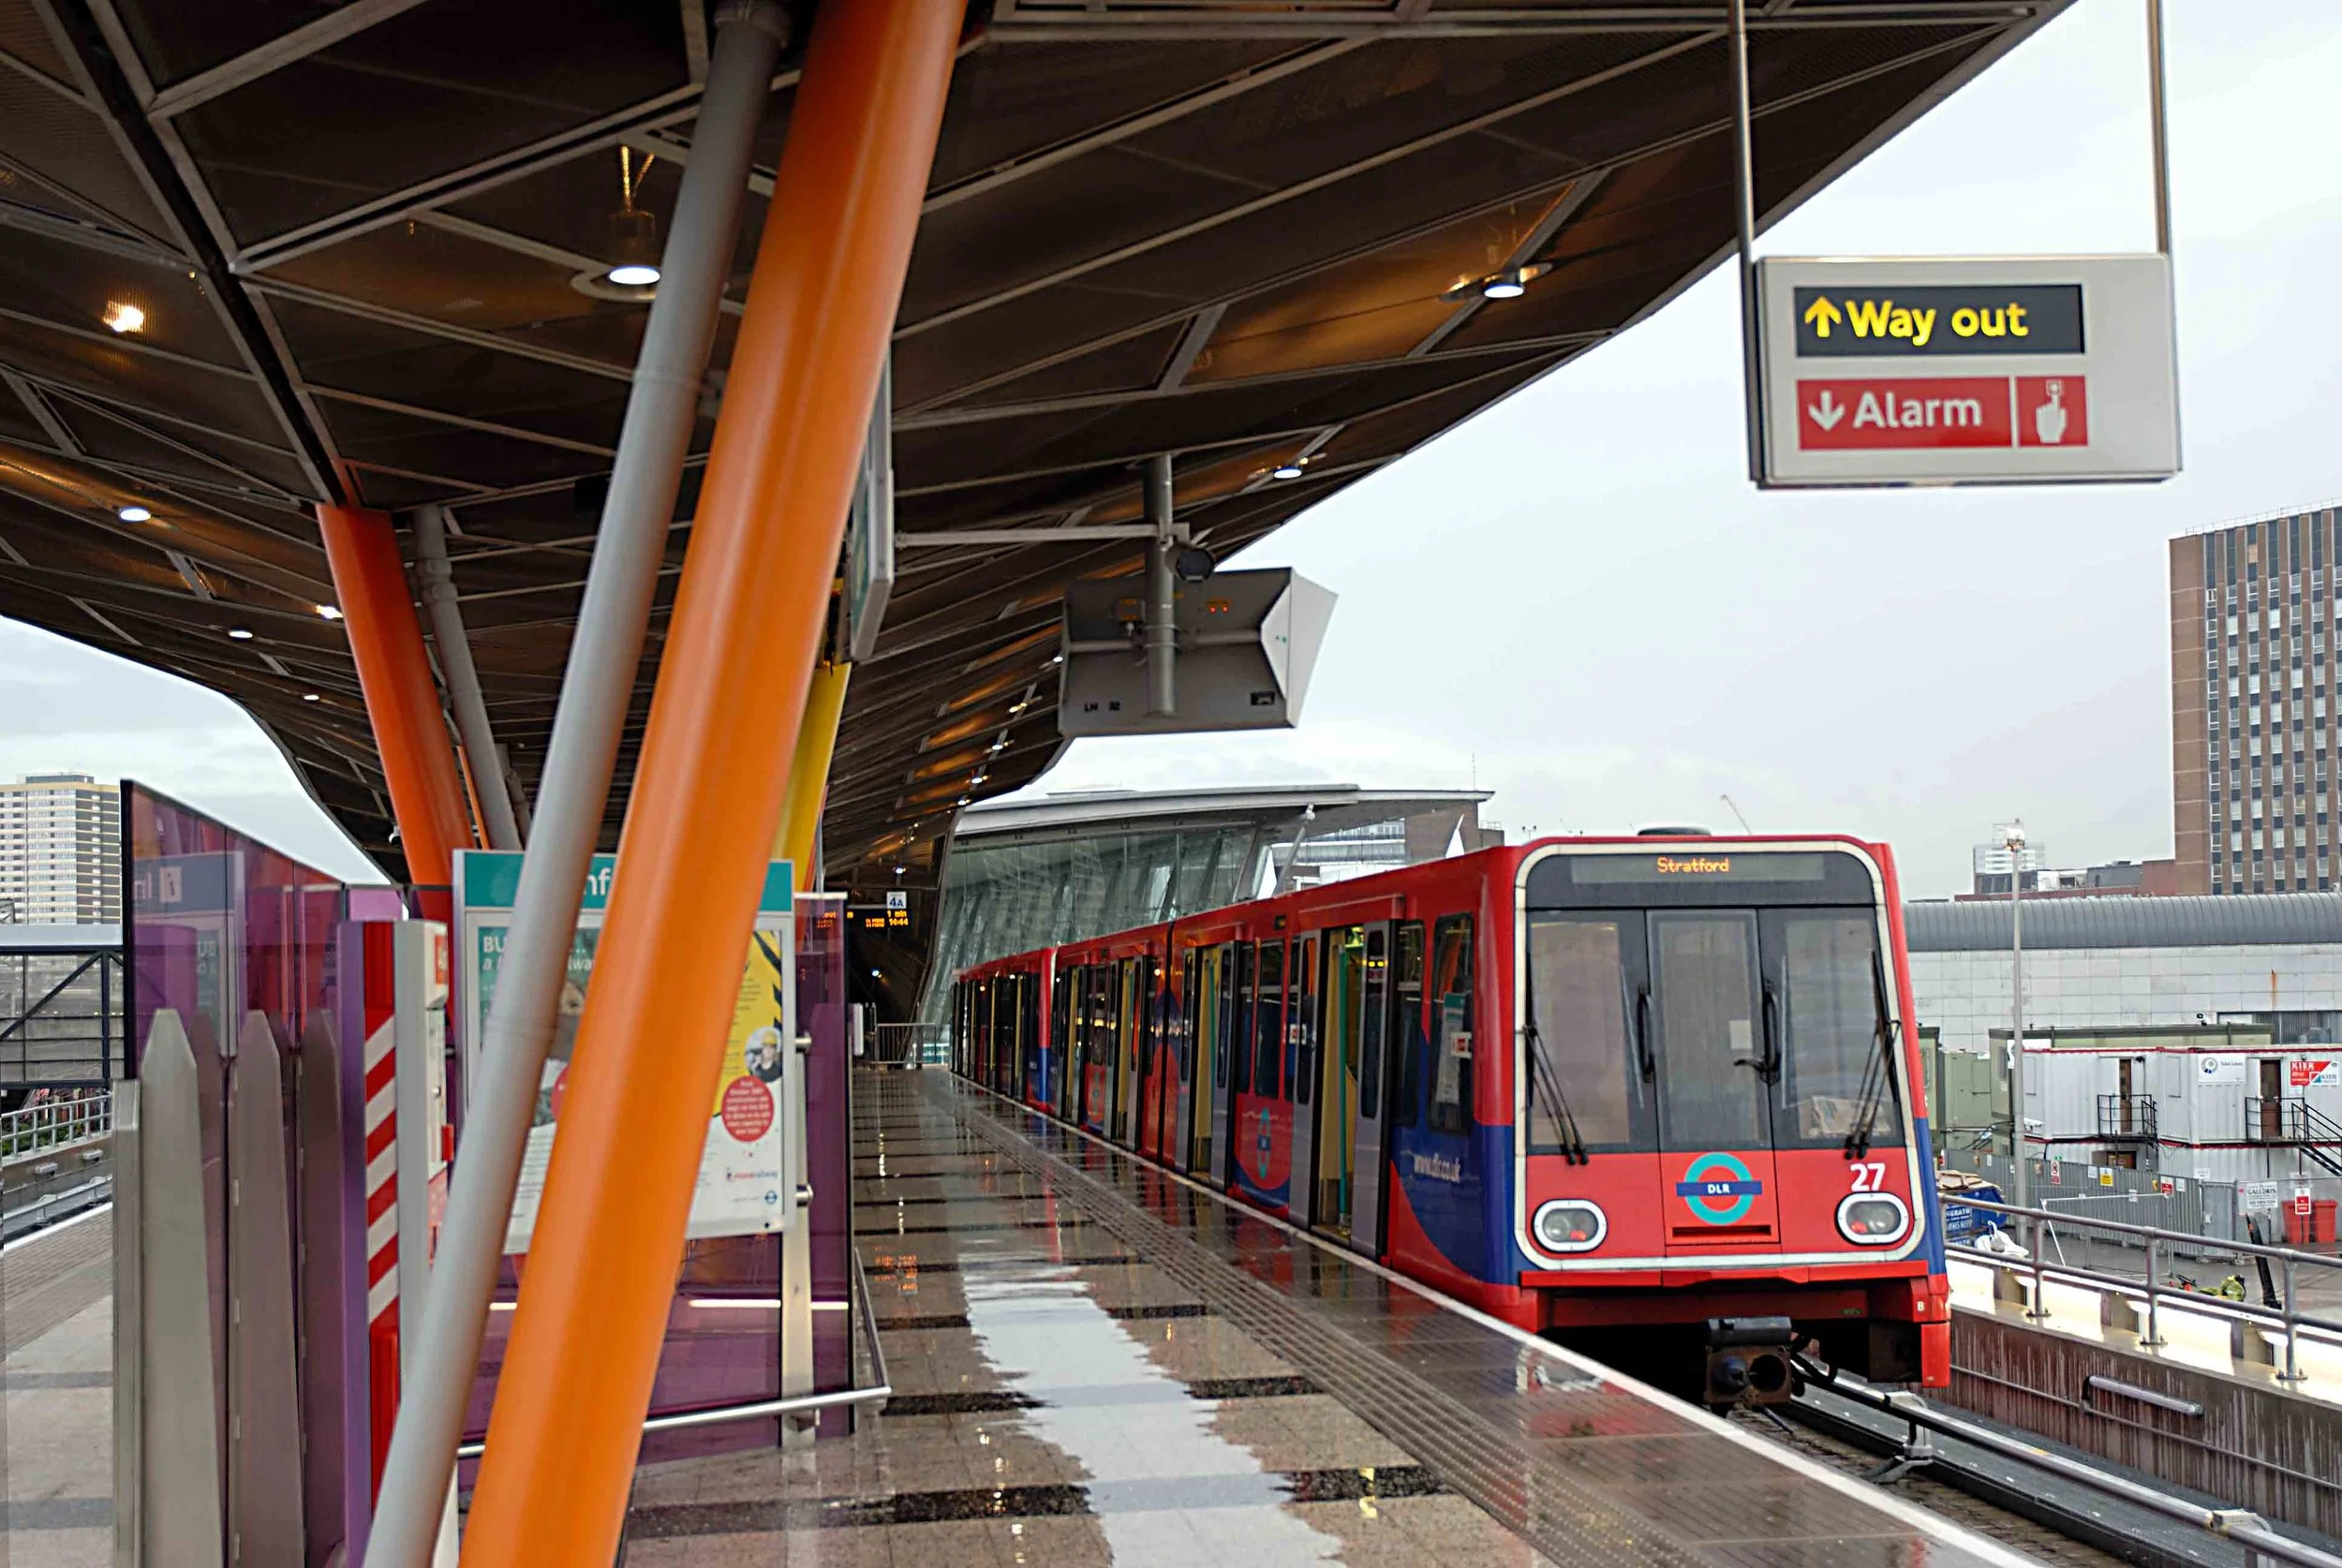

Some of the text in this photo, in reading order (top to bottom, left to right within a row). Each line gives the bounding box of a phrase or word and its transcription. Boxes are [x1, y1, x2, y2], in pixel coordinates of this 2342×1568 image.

[1845, 299, 2029, 347] Way out
[1852, 391, 1982, 430] Alarm
[1656, 855, 1730, 874] Stratford
[888, 896, 905, 908] 4A
[2291, 1061, 2314, 1072] KIER
[1849, 1162, 1886, 1192] 27
[1707, 1183, 1730, 1194] DLR
